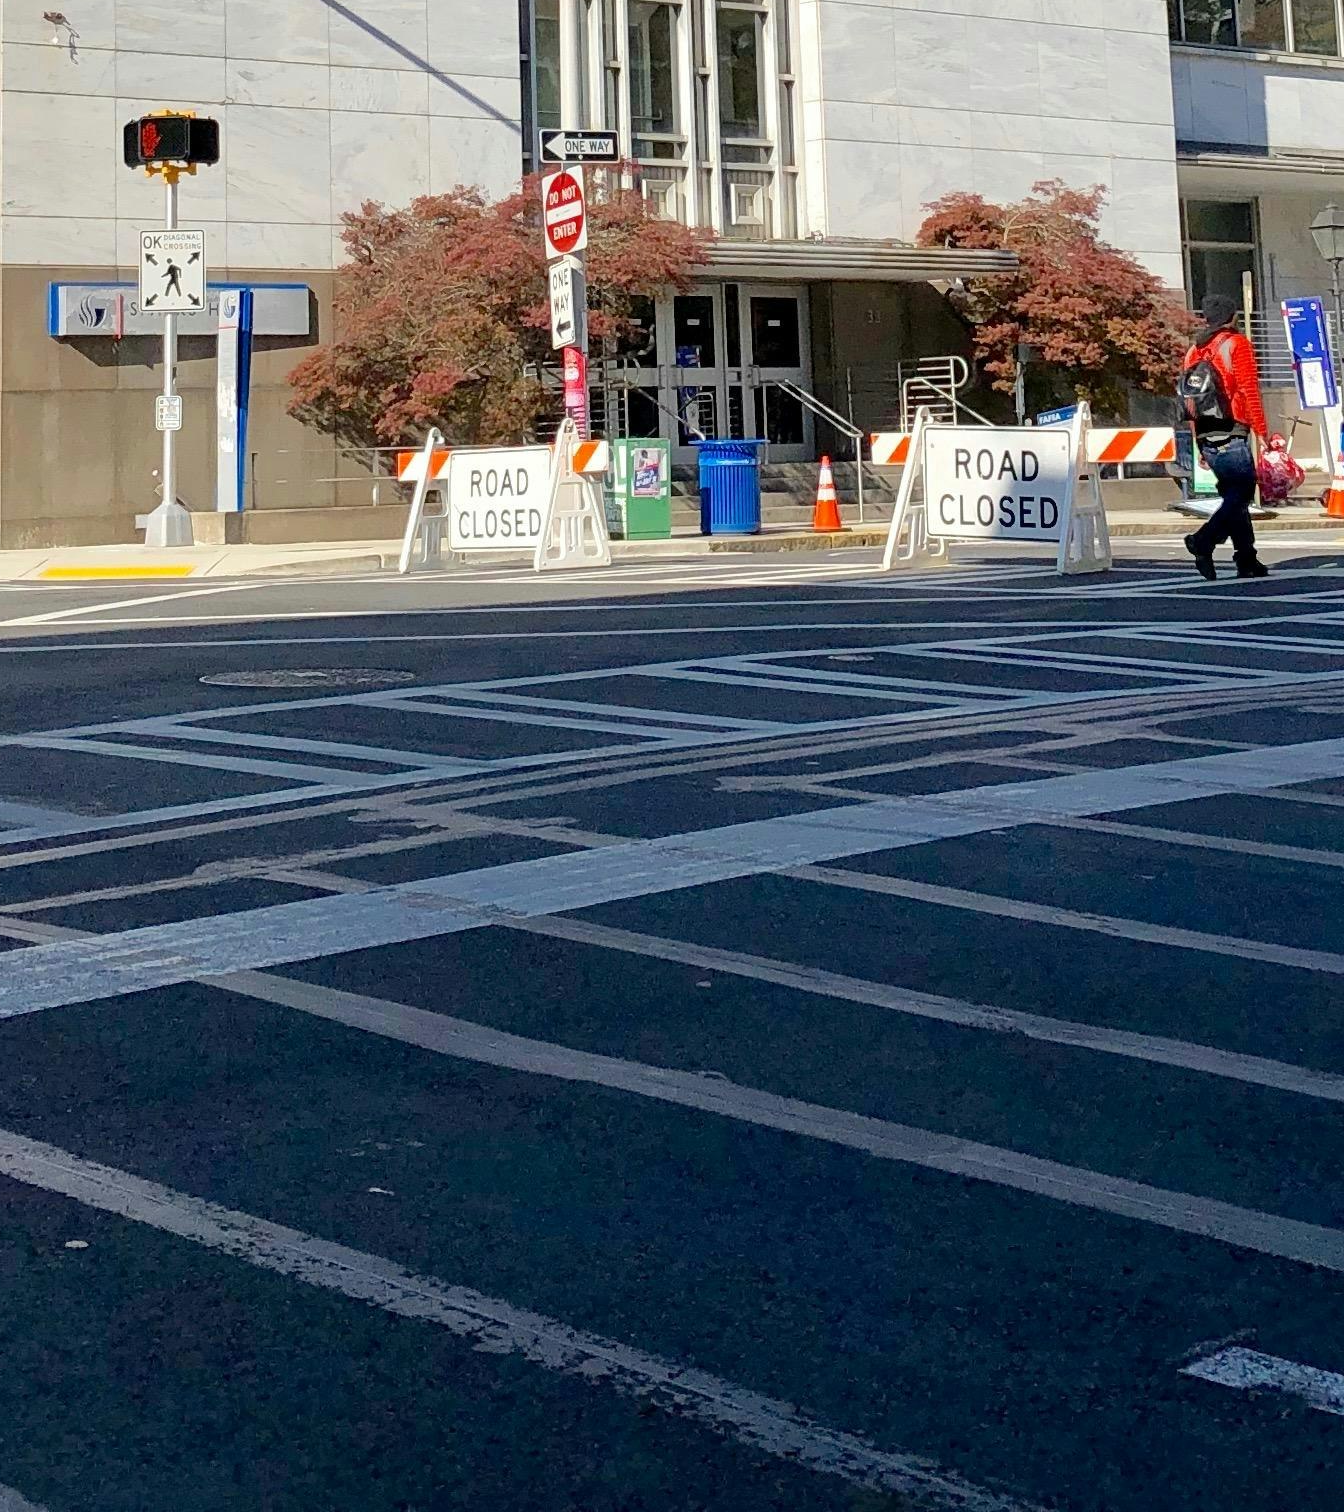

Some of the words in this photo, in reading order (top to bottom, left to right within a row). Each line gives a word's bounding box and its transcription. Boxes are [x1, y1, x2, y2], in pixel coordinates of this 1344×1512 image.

[565, 140, 586, 153] ONE
[589, 140, 610, 152] WAY
[549, 191, 559, 205] DO
[561, 185, 576, 201] NOT
[143, 235, 162, 249] OK
[553, 221, 577, 241] ENTER
[552, 267, 569, 290] ONE
[553, 292, 570, 315] WAY
[954, 449, 1039, 482] ROAD
[470, 468, 529, 497] ROAD
[459, 508, 542, 538] CLOSED
[940, 494, 1059, 529] CLOSED
